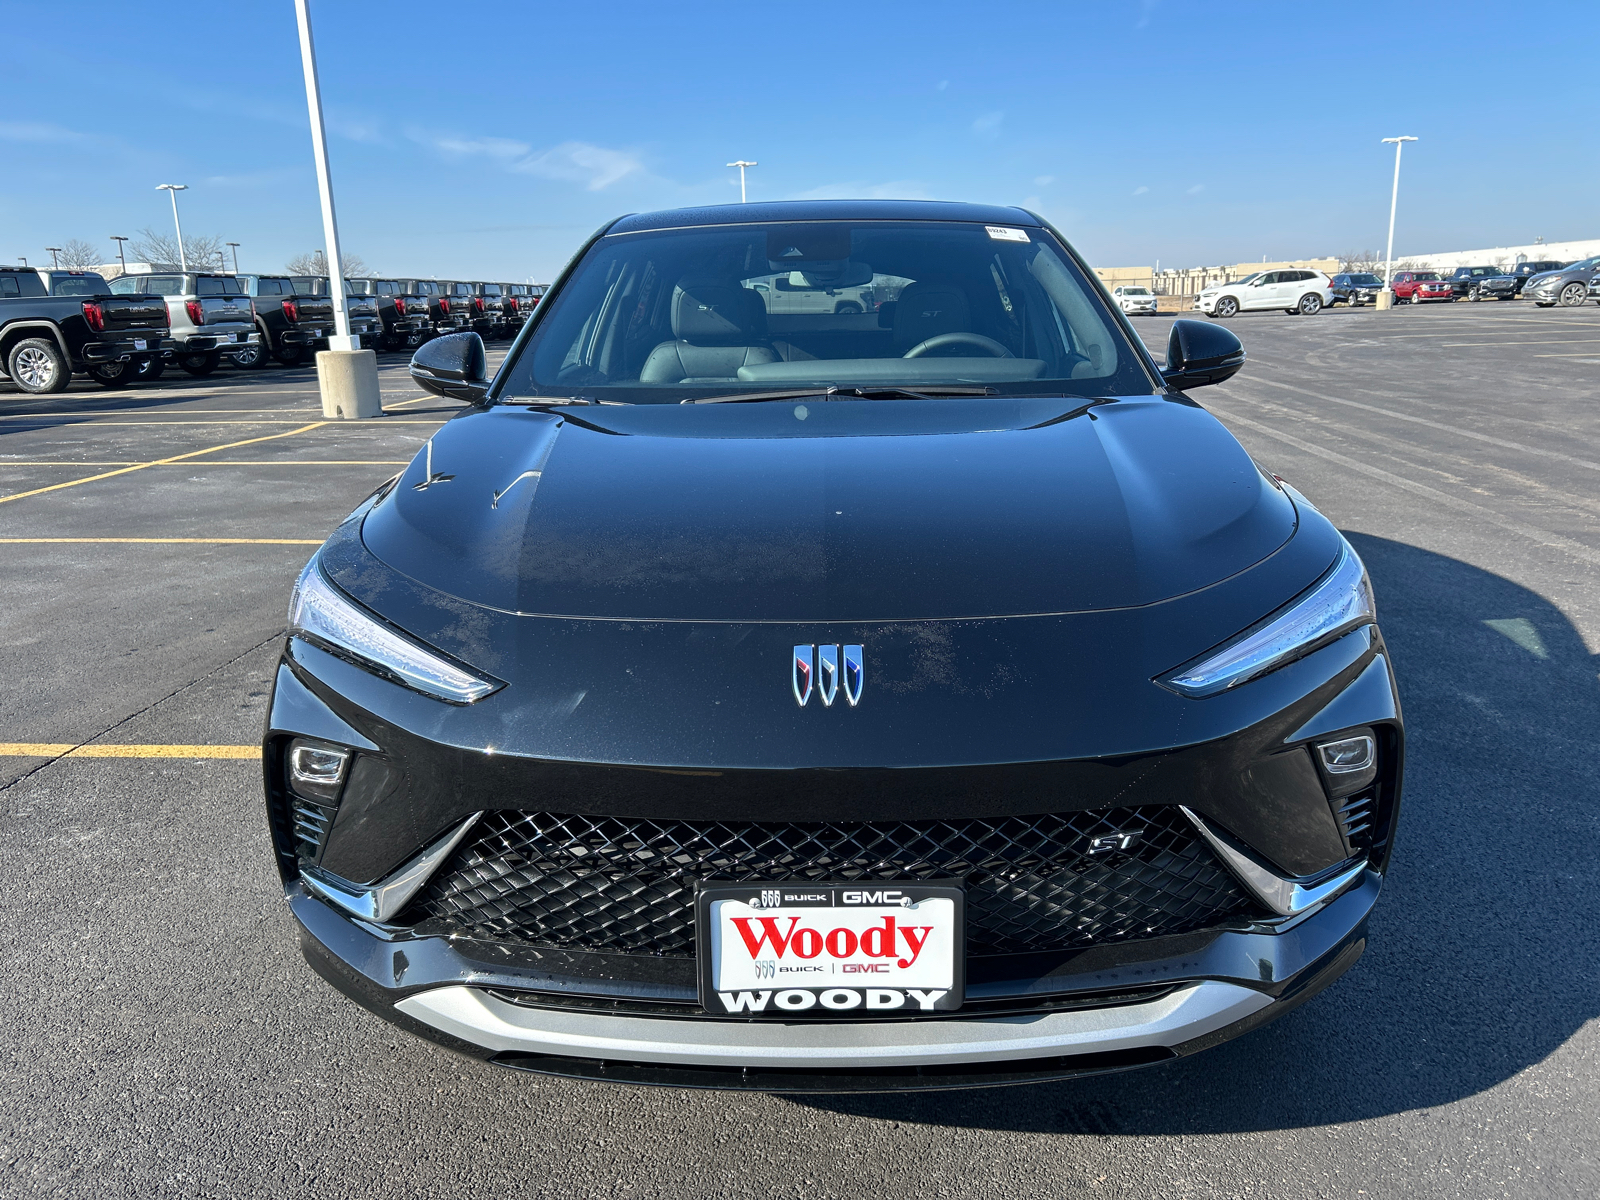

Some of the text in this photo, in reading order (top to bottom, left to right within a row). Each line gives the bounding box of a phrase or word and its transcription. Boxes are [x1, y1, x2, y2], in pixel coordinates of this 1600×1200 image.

[1088, 831, 1143, 855] ST
[784, 890, 903, 905] BUICK GMC
[729, 916, 934, 969] Woody
[779, 963, 890, 974] BUICK GMC
[717, 988, 948, 1013] WOODY
